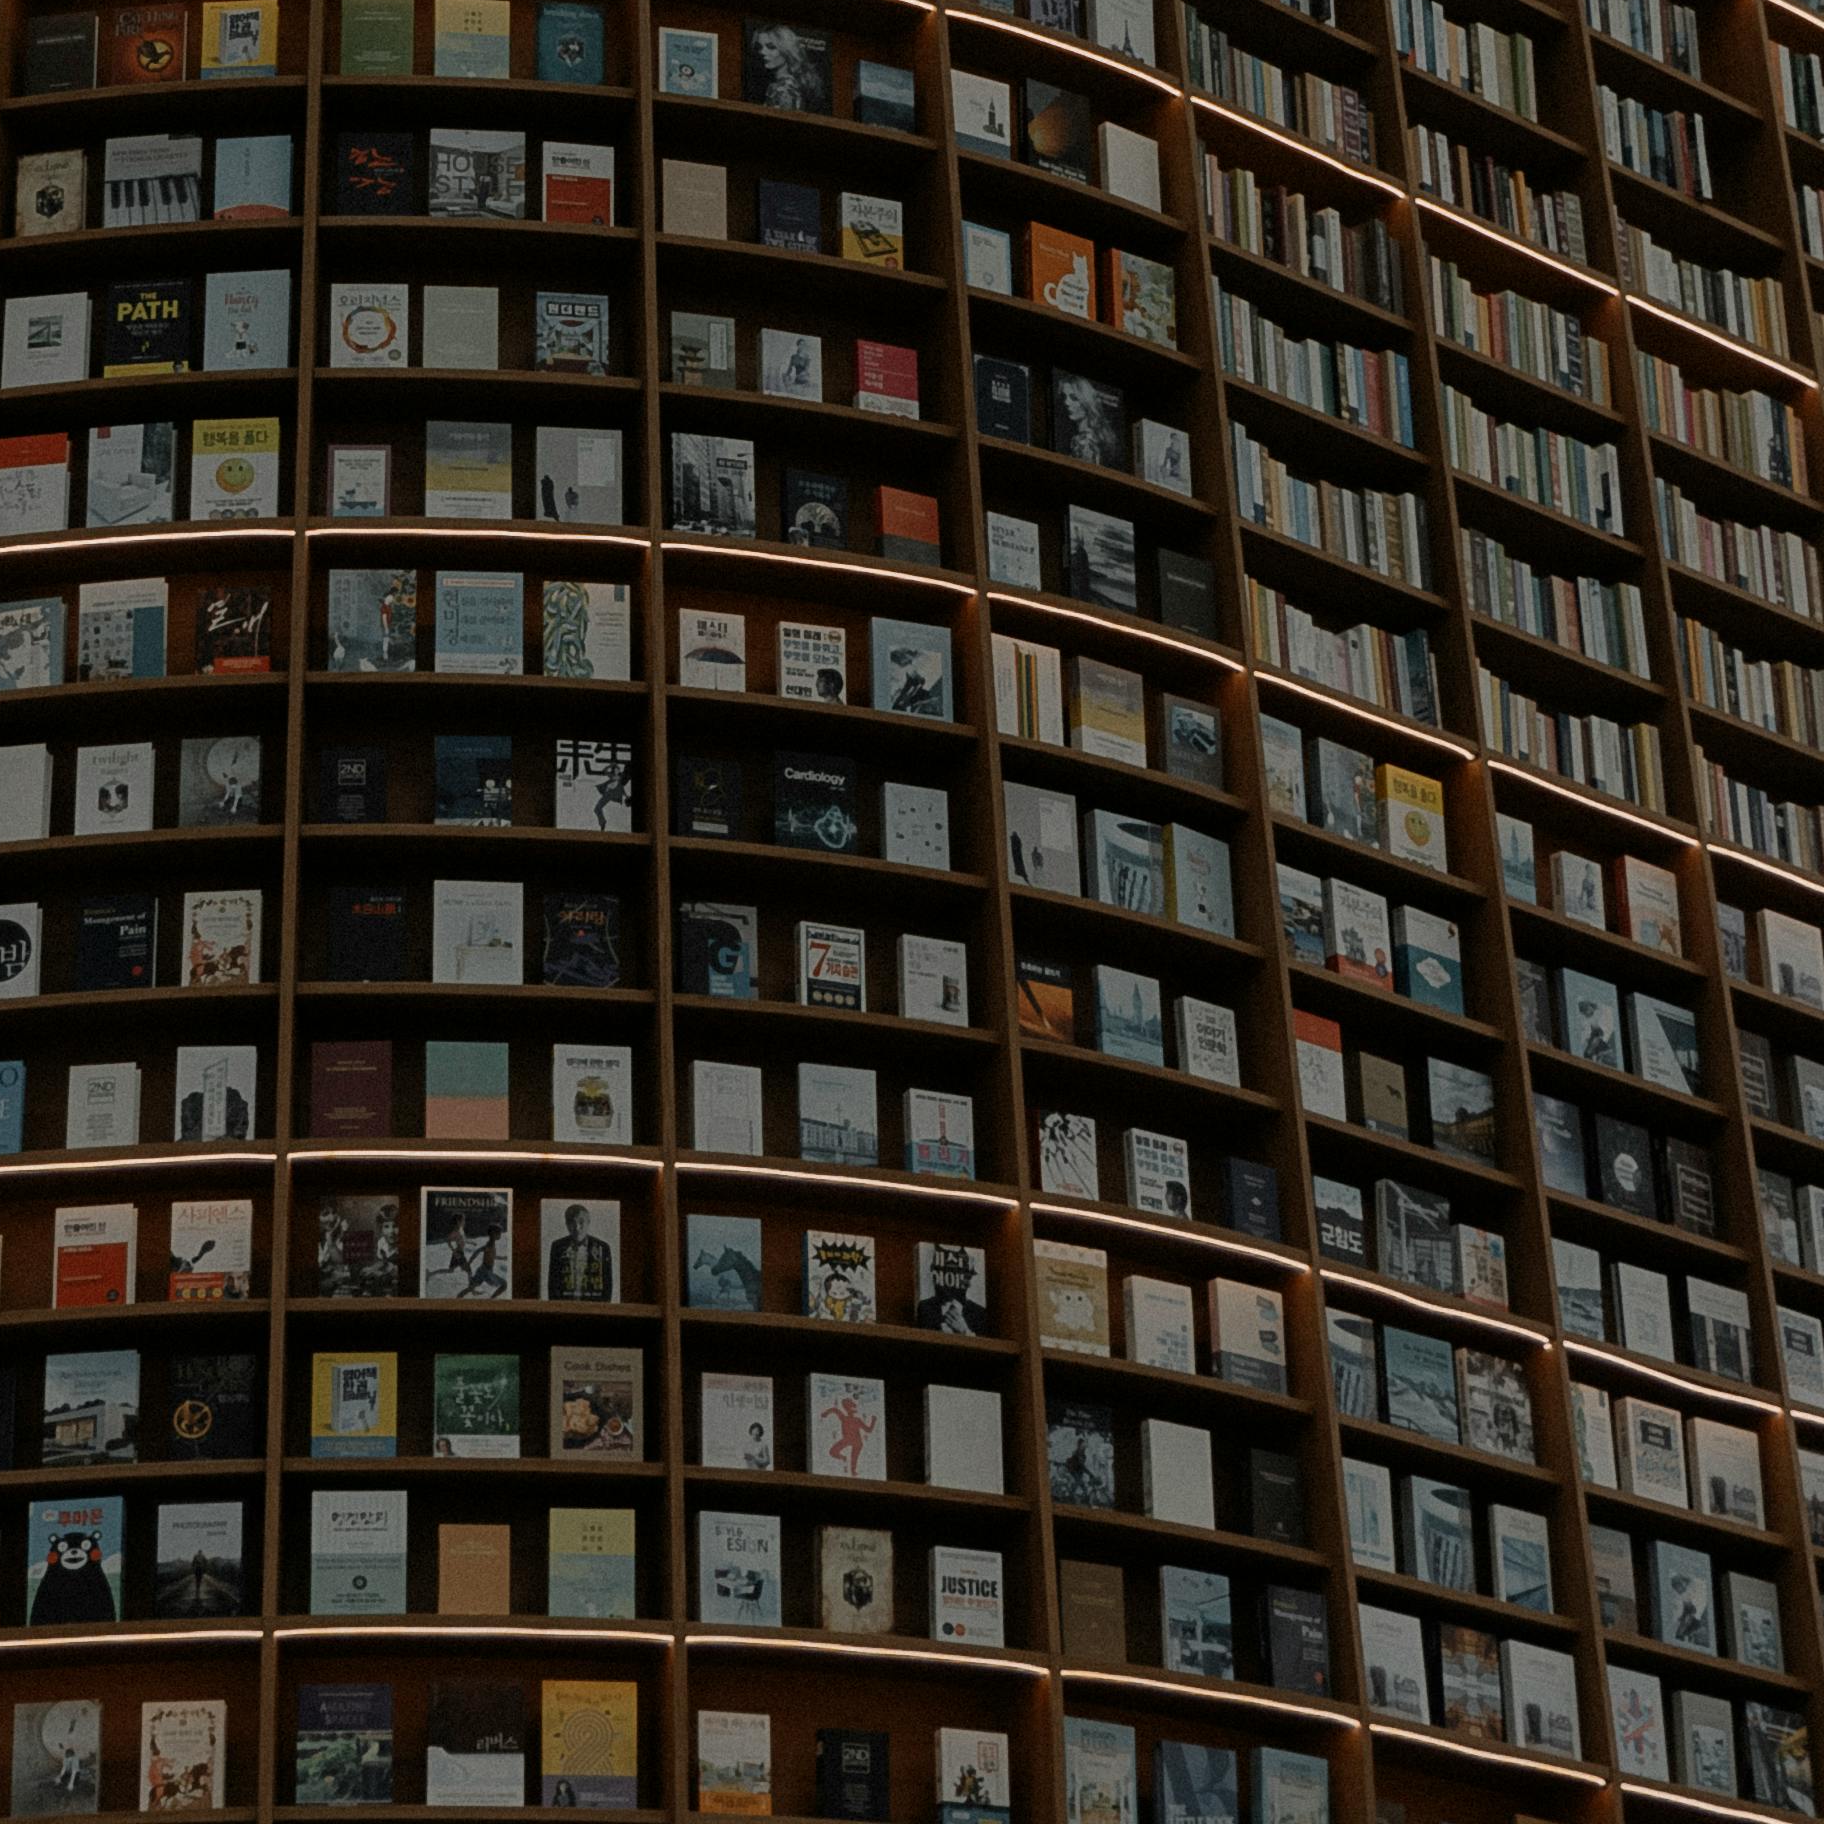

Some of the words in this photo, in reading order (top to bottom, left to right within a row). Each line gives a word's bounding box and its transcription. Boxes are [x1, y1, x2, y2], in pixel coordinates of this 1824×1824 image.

[436, 175, 521, 198] STE
[140, 291, 157, 300] THE
[117, 300, 179, 322] PATH
[202, 431, 239, 447] 행복을
[784, 767, 845, 785] Cardiology
[119, 924, 147, 937] Pain
[810, 941, 832, 978] 7
[1321, 1222, 1364, 1255] 군함도
[564, 1359, 592, 1372] Cook
[715, 1525, 743, 1537] SYLE
[942, 1575, 998, 1598] JUSTICE
